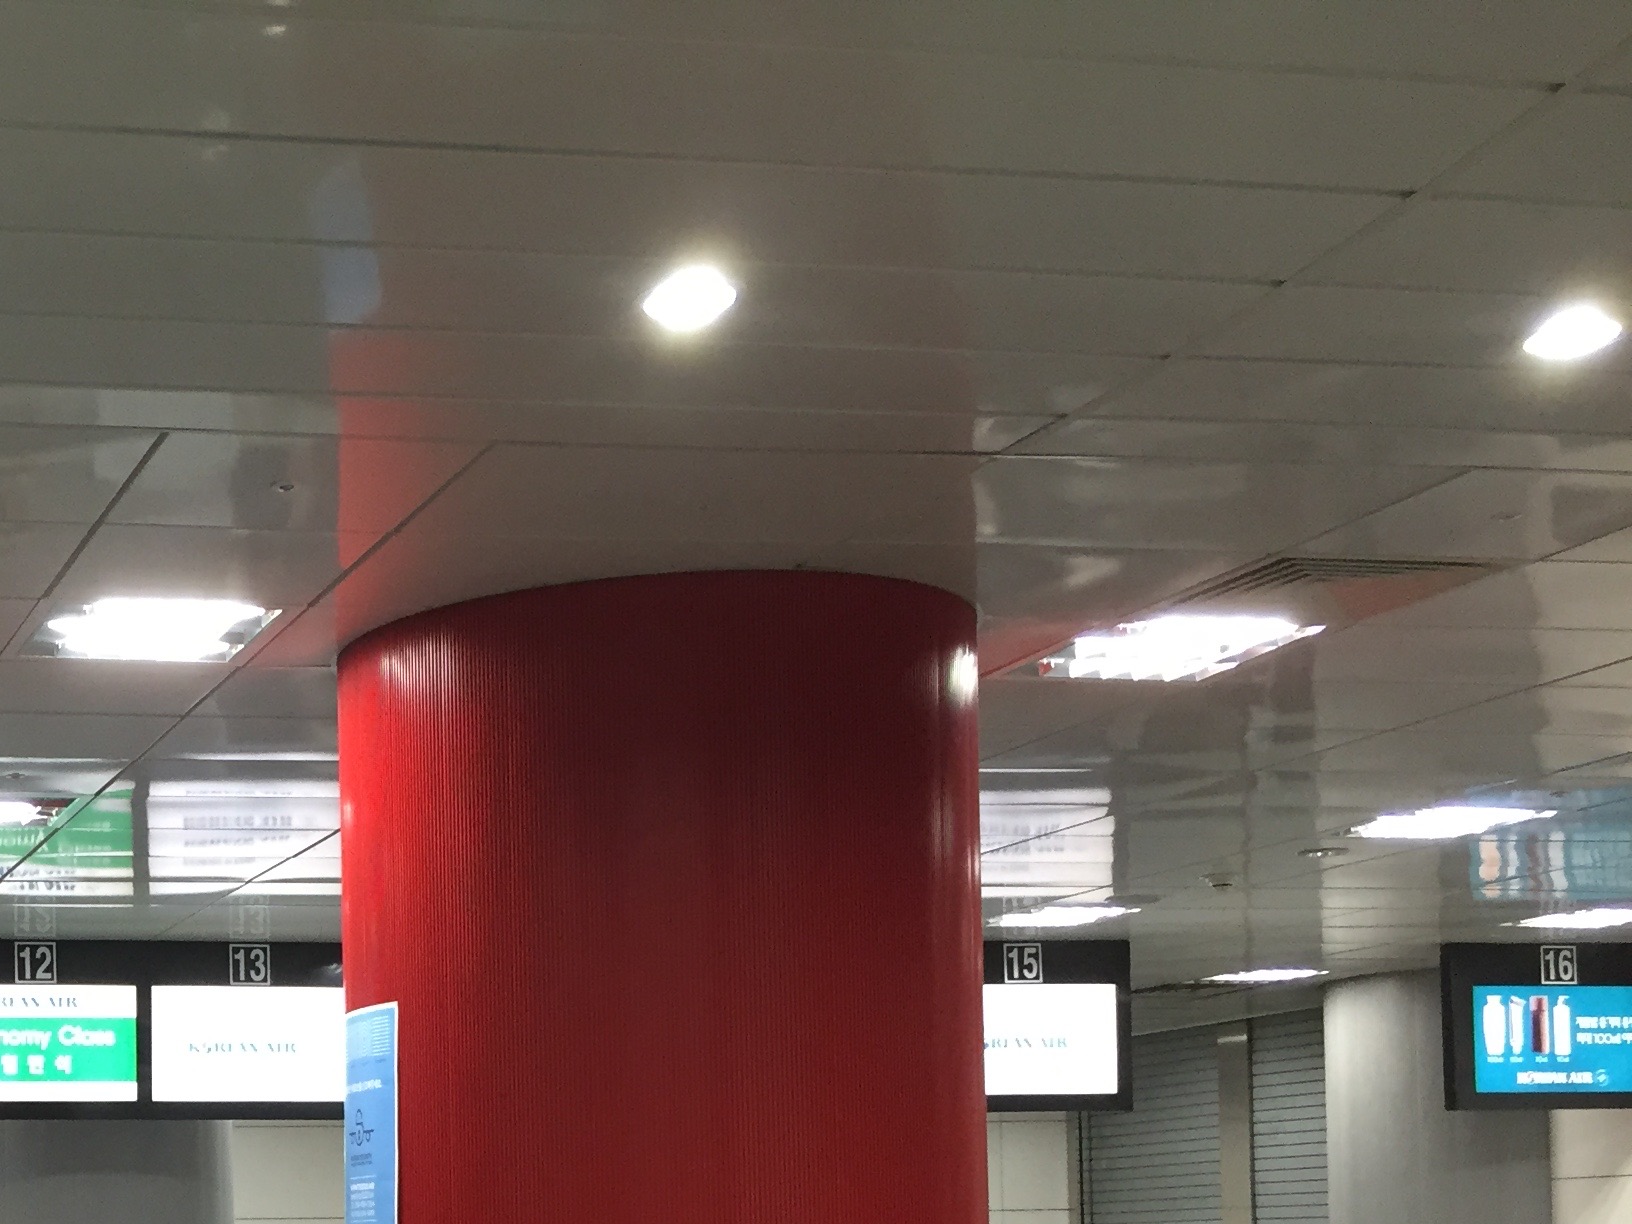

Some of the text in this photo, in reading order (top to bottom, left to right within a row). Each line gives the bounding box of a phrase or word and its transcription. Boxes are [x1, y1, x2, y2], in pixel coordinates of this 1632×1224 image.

[19, 946, 53, 980] 12
[234, 949, 267, 981] 13
[1007, 947, 1039, 980] 15
[1544, 949, 1574, 981] 16
[57, 1024, 117, 1047] Class
[1568, 1071, 1594, 1085] AIR
